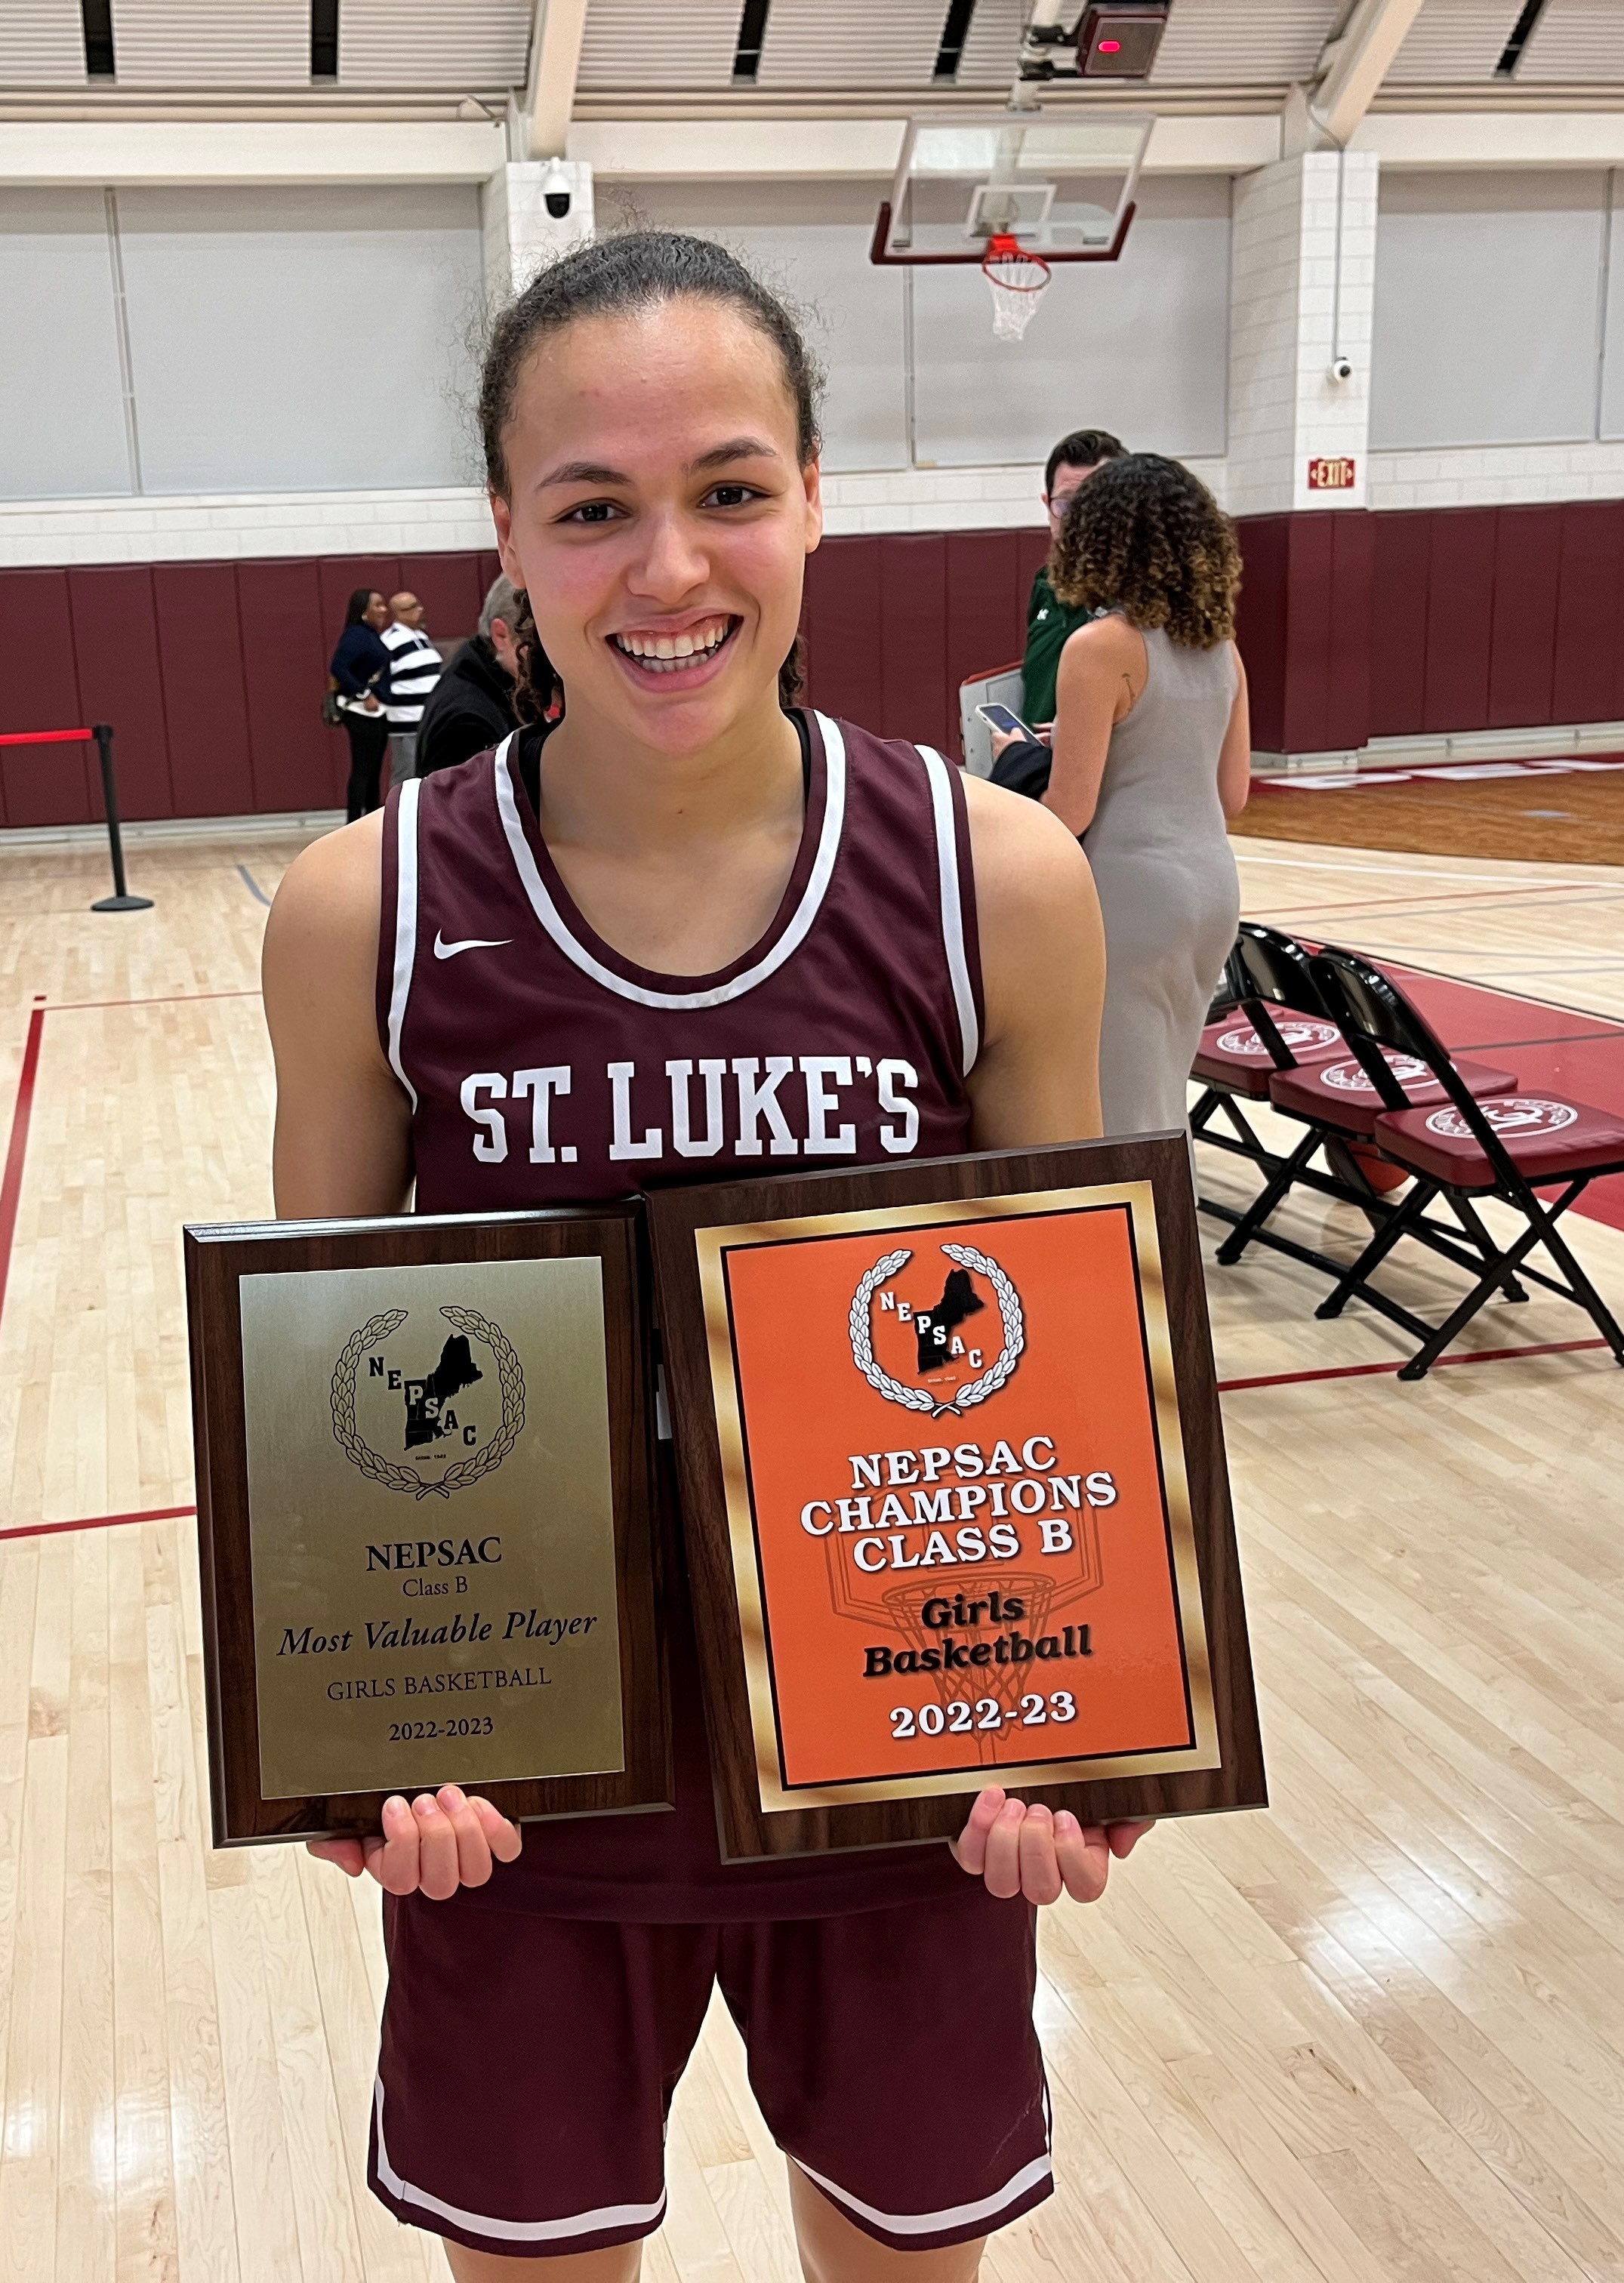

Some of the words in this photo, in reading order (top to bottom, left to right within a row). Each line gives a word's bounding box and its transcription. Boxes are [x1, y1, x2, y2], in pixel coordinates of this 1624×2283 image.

[1317, 461, 1347, 487] EXIT
[460, 1065, 578, 1163] ST.
[607, 1055, 919, 1160] LUKE'S
[848, 1436, 1056, 1490] NEPSAC
[800, 1471, 1117, 1536] CHAMPIONS
[365, 1536, 502, 1572] NEPSAC
[853, 1524, 1019, 1572] CLASS
[1037, 1518, 1073, 1554] B
[402, 1578, 449, 1597] Class
[455, 1576, 468, 1594] B
[921, 1591, 1025, 1629] Girls
[276, 1626, 353, 1656] Most
[365, 1613, 492, 1650] Valuable
[502, 1609, 597, 1646] Player
[863, 1624, 1092, 1677] Basketball
[327, 1678, 396, 1700] GIRLS
[404, 1667, 552, 1695] BASKETBALL
[389, 1717, 494, 1741] 2022-2023
[889, 1690, 1076, 1738] 2022-23
